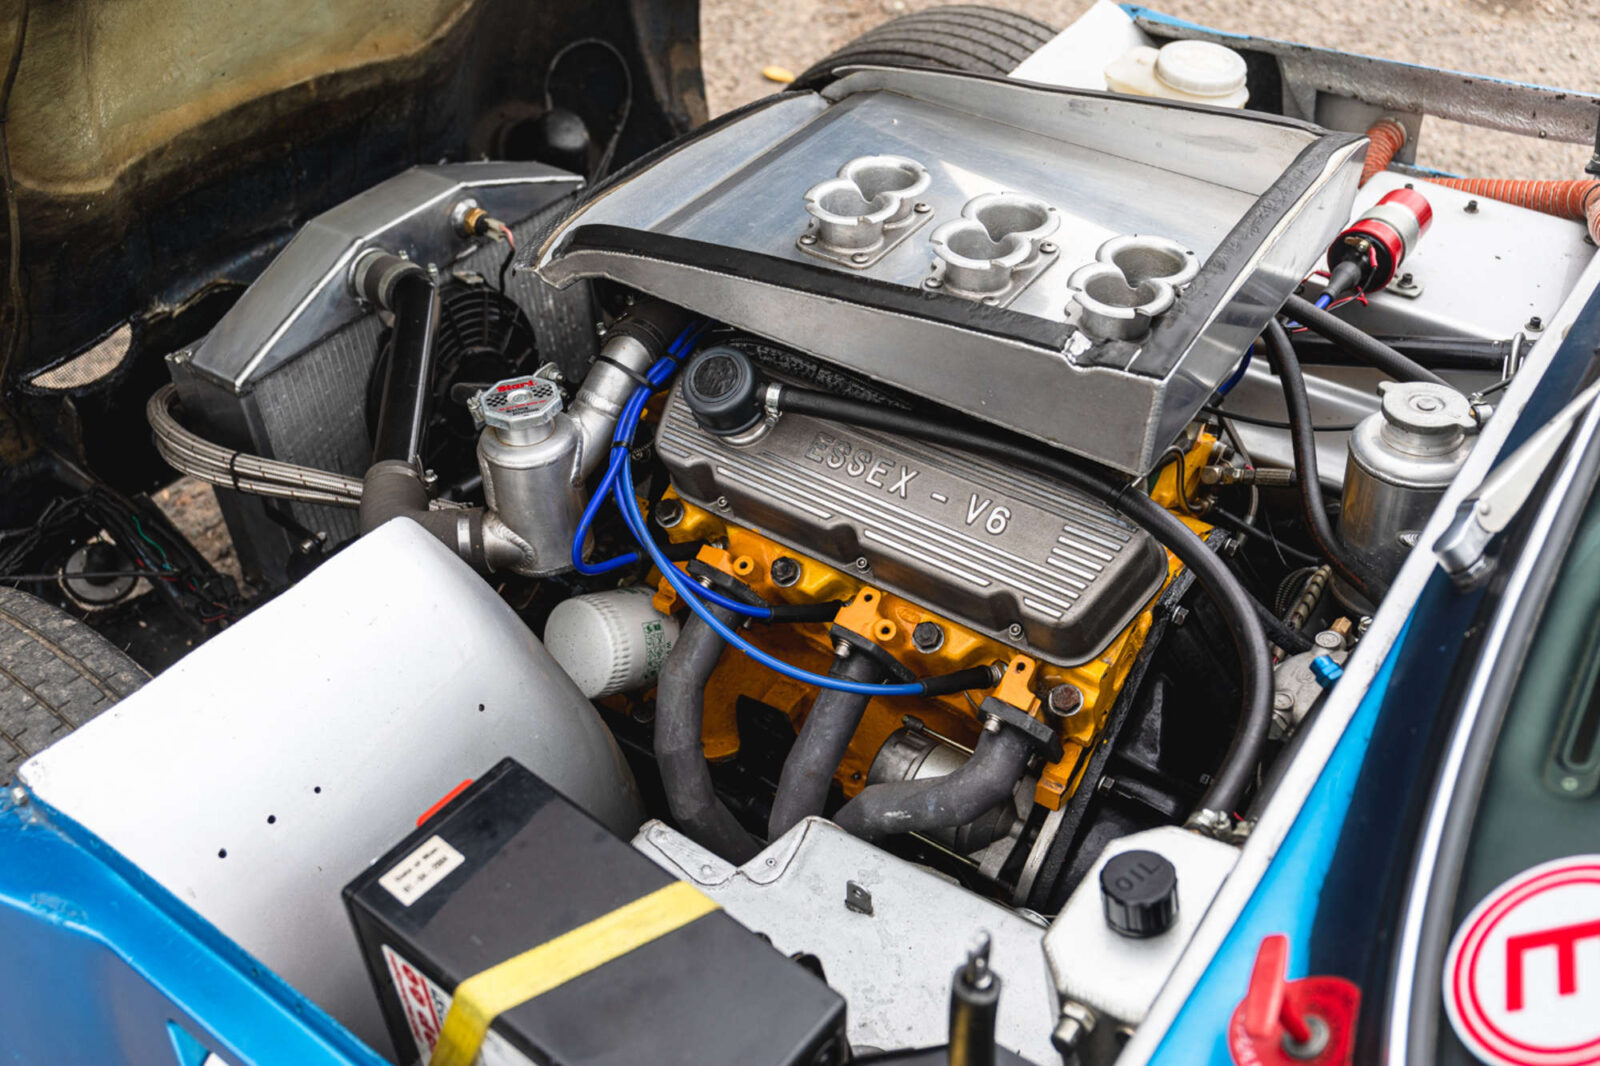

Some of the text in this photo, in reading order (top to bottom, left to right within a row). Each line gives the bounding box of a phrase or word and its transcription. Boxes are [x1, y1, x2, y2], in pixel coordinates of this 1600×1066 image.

[804, 431, 920, 499] ESSEX
[964, 492, 1012, 535] V6
[1115, 861, 1162, 892] OIL
